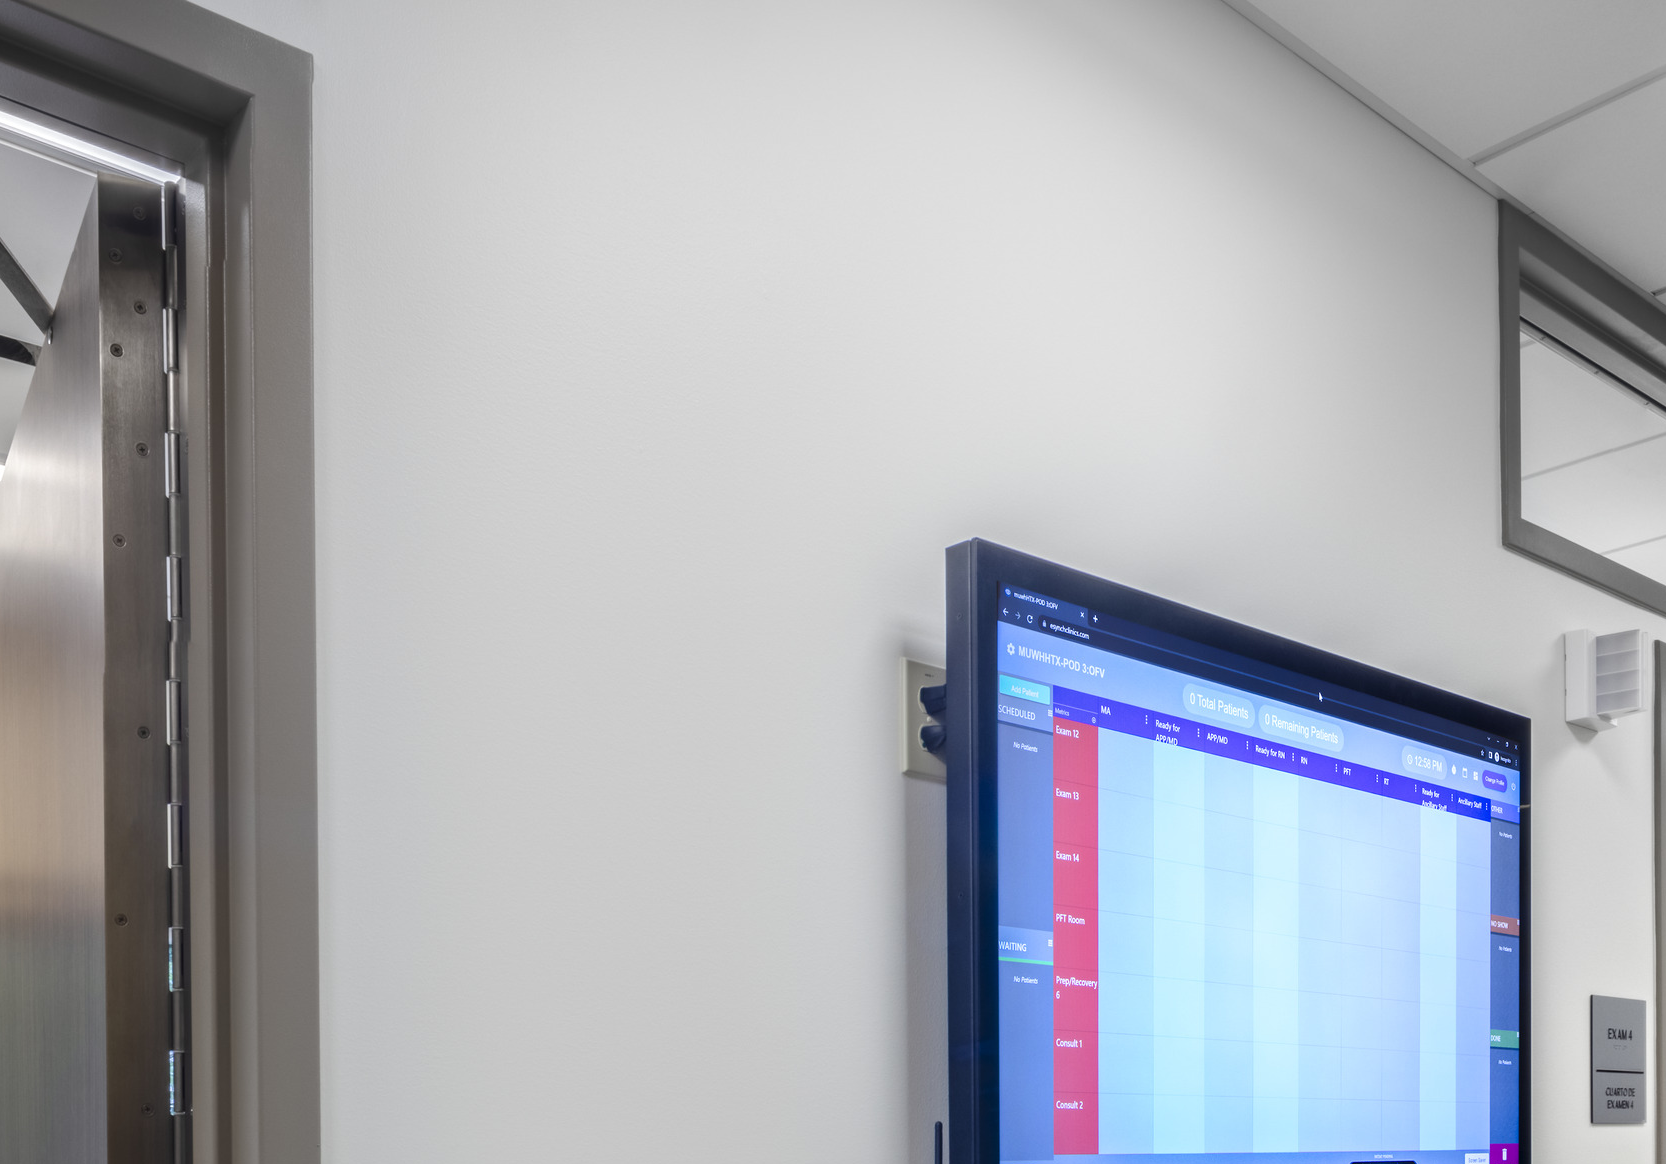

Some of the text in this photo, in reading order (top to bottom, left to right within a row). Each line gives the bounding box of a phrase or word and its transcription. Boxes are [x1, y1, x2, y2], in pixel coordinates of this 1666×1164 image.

[1050, 623, 1089, 640] esynchclinics.com
[1018, 645, 1105, 679] MUWHHTX-POD 3:OFV
[1011, 685, 1039, 699] Add Patient
[998, 704, 1036, 721] SCHEDULED
[1055, 707, 1070, 717] Metrics
[1101, 705, 1111, 716] MA
[1189, 692, 1249, 721] 0 Total Patients
[1055, 725, 1080, 739] Exam 12
[1155, 719, 1181, 733] Ready for
[1264, 713, 1339, 745] 0 Remaining Patients
[1155, 734, 1178, 747] APP/MD
[1206, 732, 1229, 745] APP/MD
[1013, 741, 1038, 753] No Patients
[1255, 744, 1270, 757] Ready
[1277, 751, 1286, 760] RN
[1300, 756, 1308, 765] RN
[1414, 755, 1443, 773] 12:58 PM
[1343, 767, 1352, 777] PFT
[1383, 777, 1390, 786] RT
[1055, 788, 1080, 800] Exam 13
[1421, 787, 1434, 799] Ready
[1458, 796, 1483, 810] Ancillary Staff
[1491, 805, 1503, 815] OTHER
[1055, 850, 1080, 862] Exam 14
[1055, 913, 1085, 925] PFT Room
[1497, 921, 1508, 929] SHOW
[999, 941, 1027, 952] WAITING
[1013, 975, 1038, 985] No Patients
[1055, 975, 1098, 989] Prep/Recovery
[1055, 990, 1061, 999] 6
[1607, 1028, 1633, 1040] EXAM 4
[1055, 1038, 1078, 1047] Consult
[1605, 1087, 1635, 1097] CUARTO DE
[1055, 1101, 1078, 1110] Consult
[1607, 1100, 1629, 1109] EXAMEN
